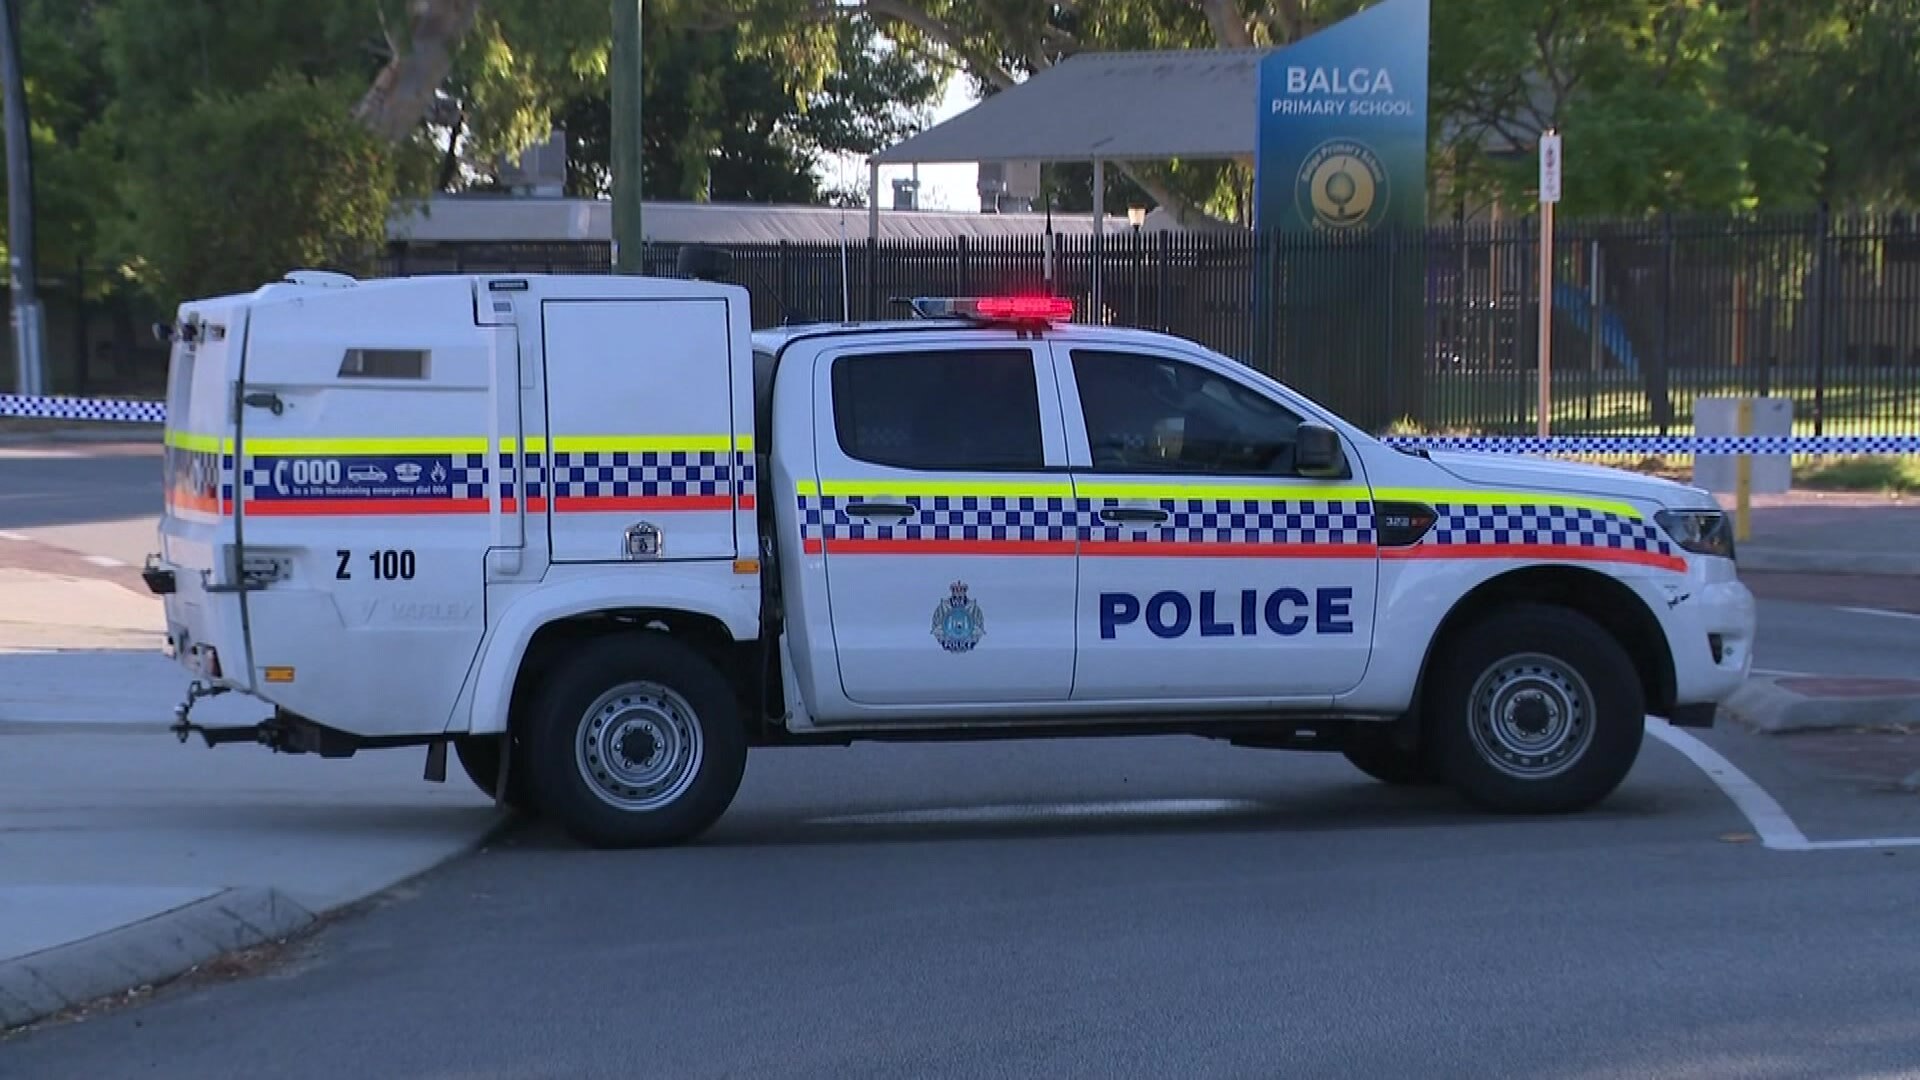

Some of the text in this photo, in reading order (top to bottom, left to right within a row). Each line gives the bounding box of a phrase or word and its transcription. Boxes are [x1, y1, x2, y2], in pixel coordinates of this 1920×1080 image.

[1286, 66, 1394, 94] BALGA
[1271, 99, 1414, 116] PRIMARY SCHOOL
[293, 460, 341, 485] 000
[372, 487, 415, 497] emergency
[416, 485, 431, 496] dial
[335, 549, 416, 581] Z 100
[1099, 586, 1354, 640] POLICE
